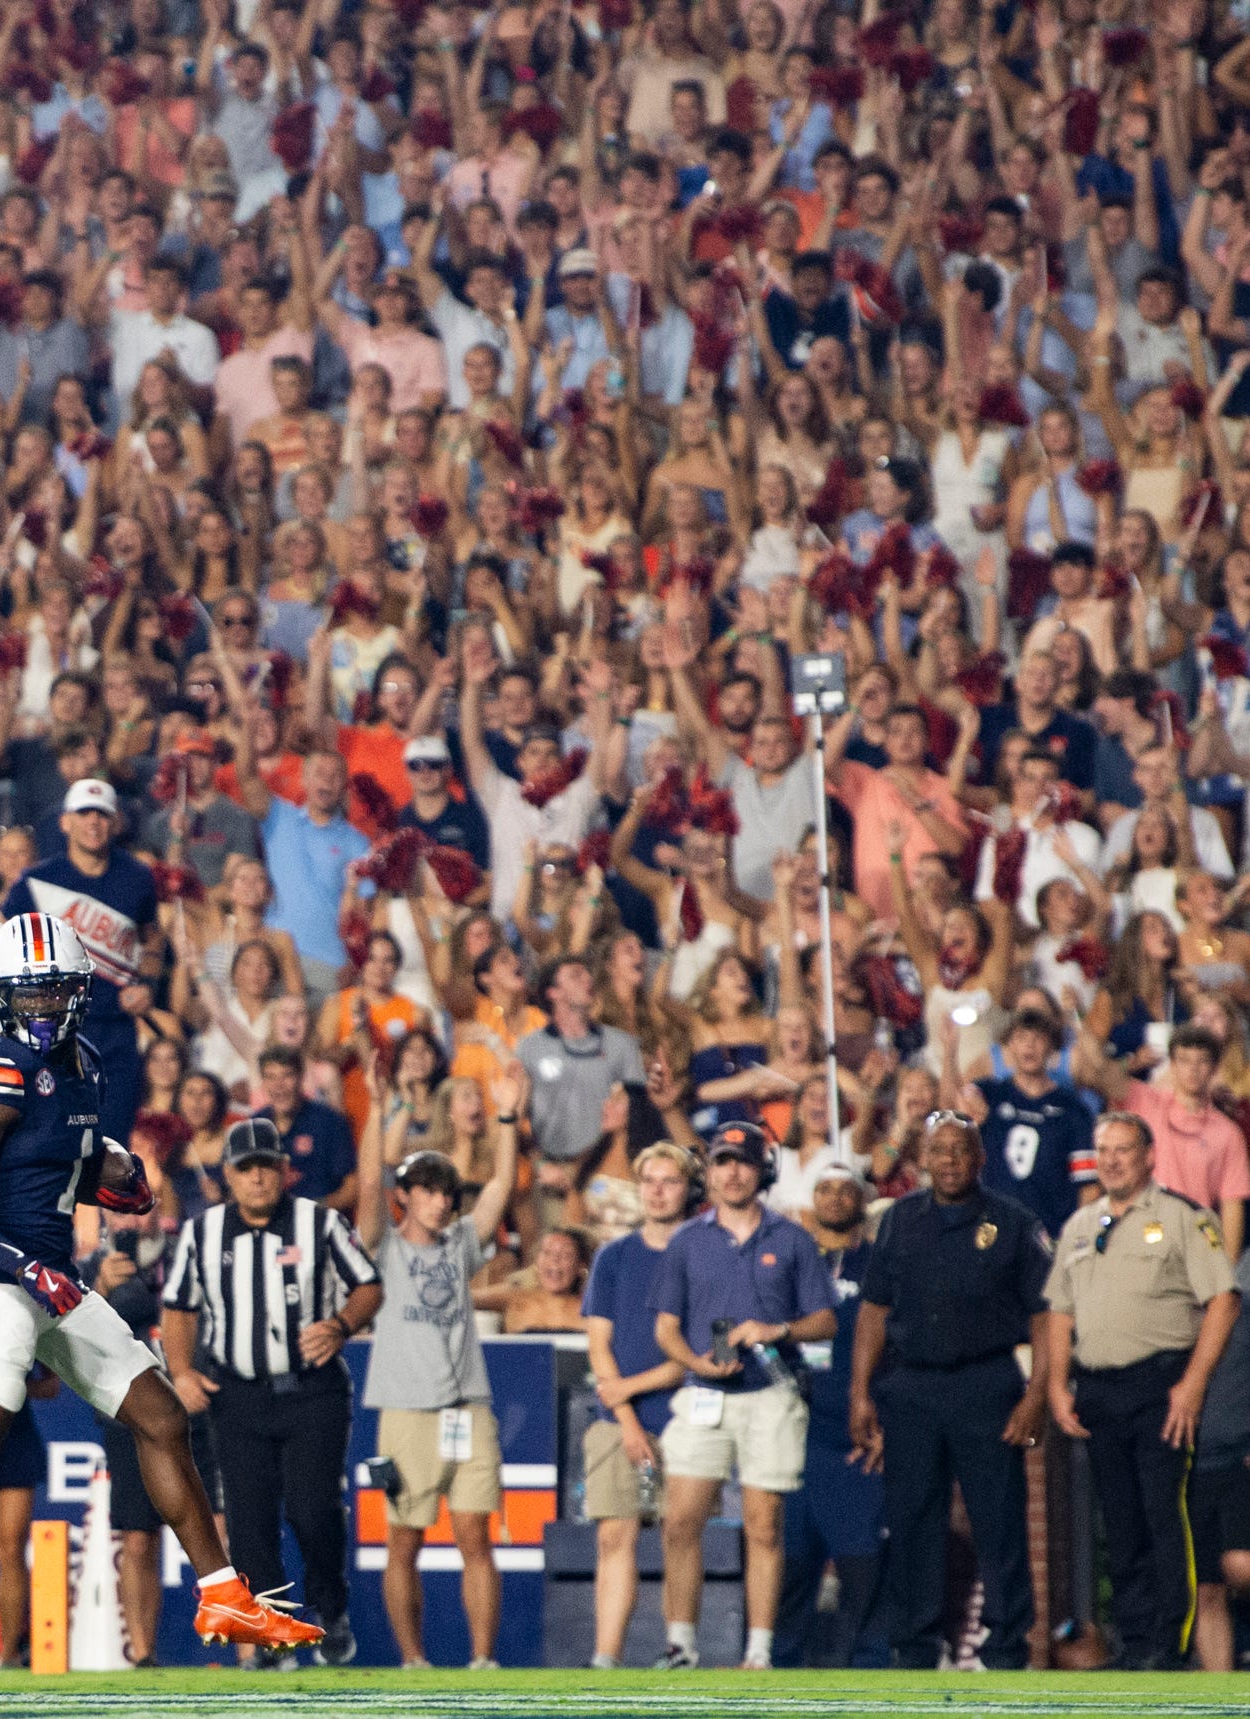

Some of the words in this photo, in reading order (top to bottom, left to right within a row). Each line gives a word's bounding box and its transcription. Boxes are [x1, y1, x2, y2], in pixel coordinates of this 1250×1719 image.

[67, 1113, 99, 1127] AUBURN
[57, 1128, 93, 1215] 1
[285, 1283, 300, 1305] S
